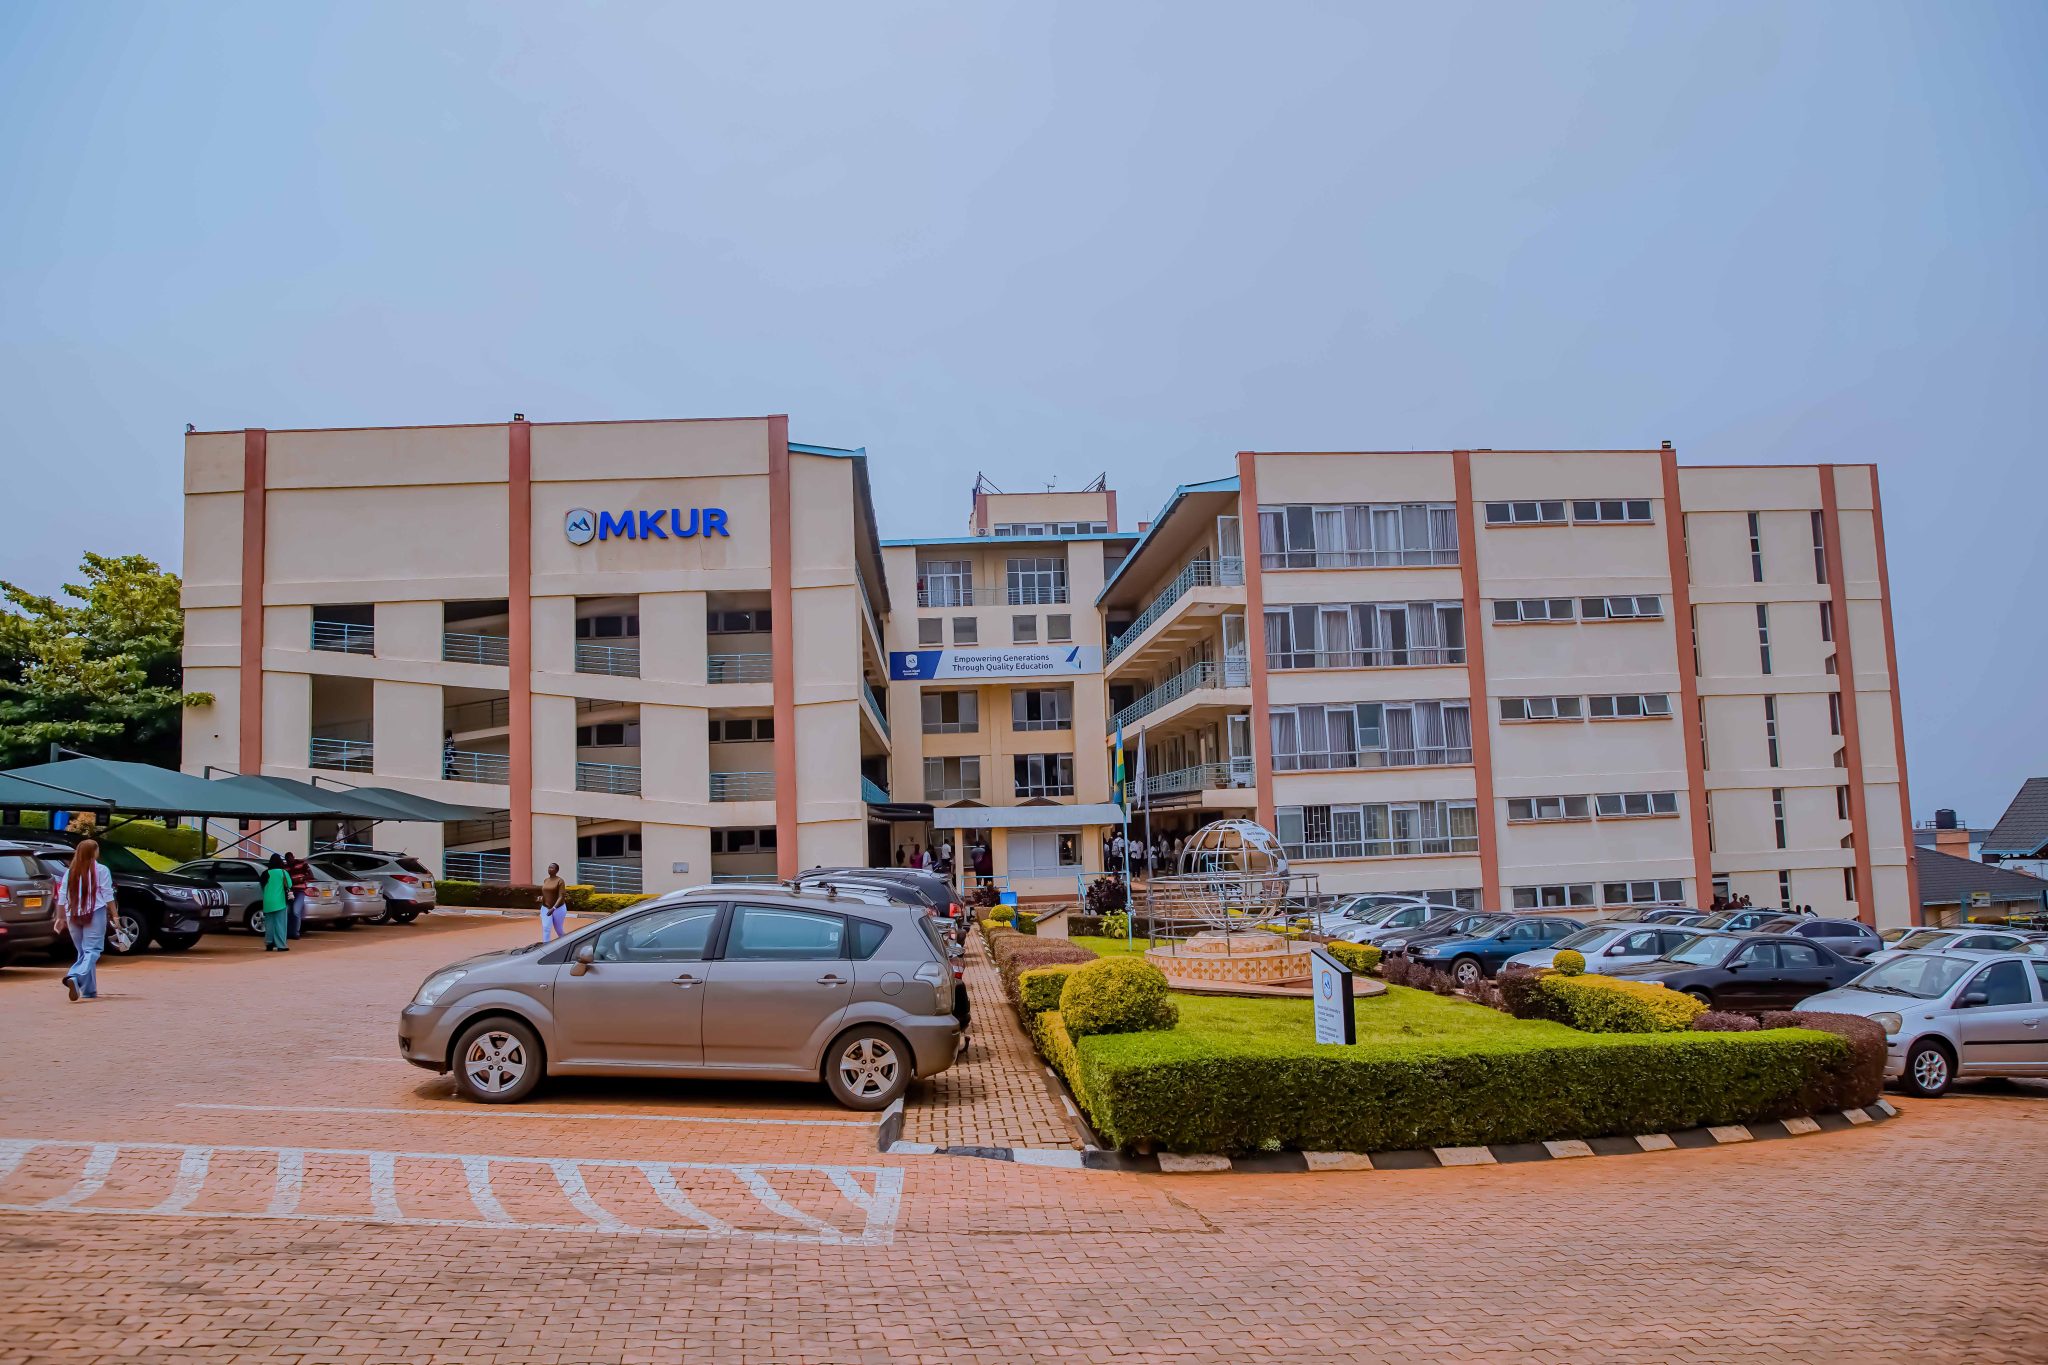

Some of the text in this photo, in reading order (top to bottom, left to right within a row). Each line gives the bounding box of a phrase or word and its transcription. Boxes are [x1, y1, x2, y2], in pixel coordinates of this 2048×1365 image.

[598, 508, 730, 541] MKUR
[954, 653, 1050, 663] Empowering Generations
[952, 661, 1054, 672] Through Quality Education
